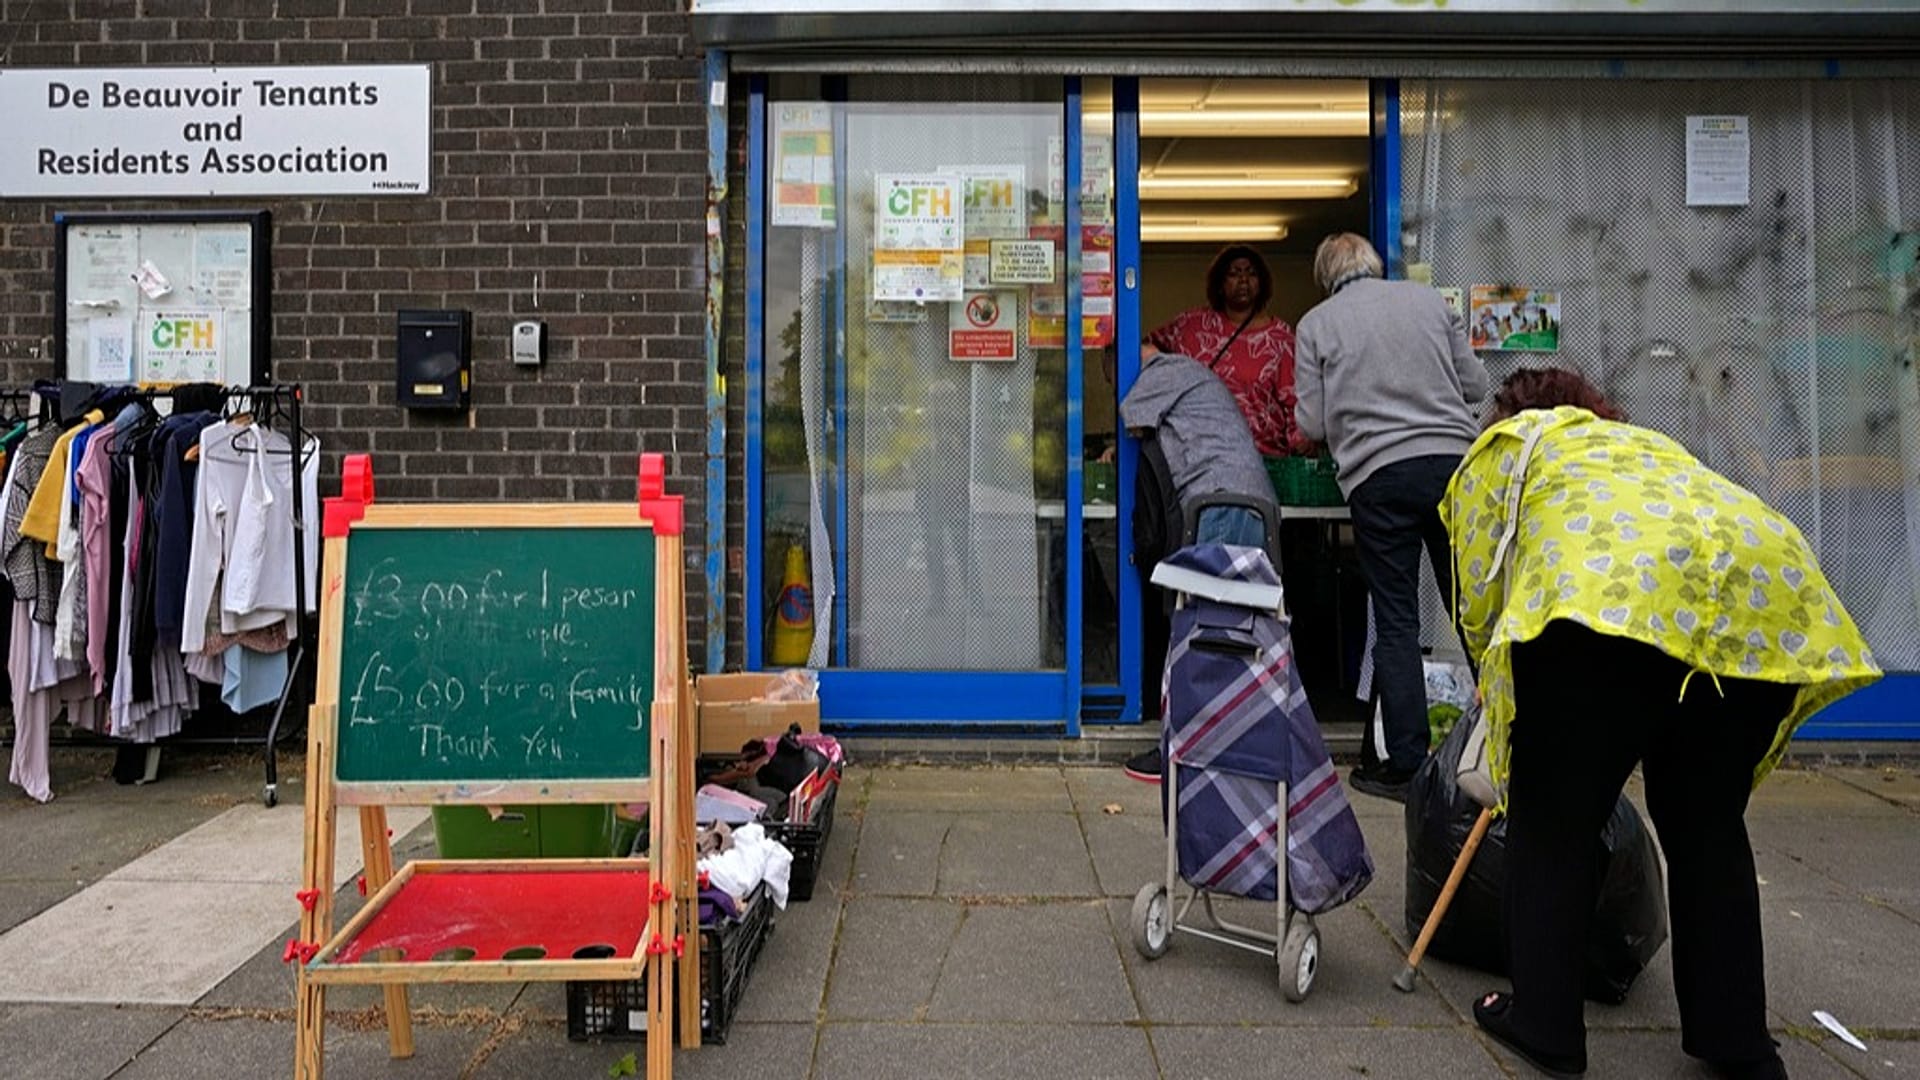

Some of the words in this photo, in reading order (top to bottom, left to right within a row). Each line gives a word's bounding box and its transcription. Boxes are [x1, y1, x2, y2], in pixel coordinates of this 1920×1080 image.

[48, 82, 90, 108] De
[103, 81, 243, 107] Beauvoir
[252, 80, 379, 107] Tenants
[183, 115, 242, 142] and
[38, 147, 189, 174] Residents
[201, 146, 388, 173] Association
[888, 188, 951, 216] CFH
[153, 321, 213, 349] CFH
[568, 668, 643, 730] family
[409, 724, 499, 761] Thank
